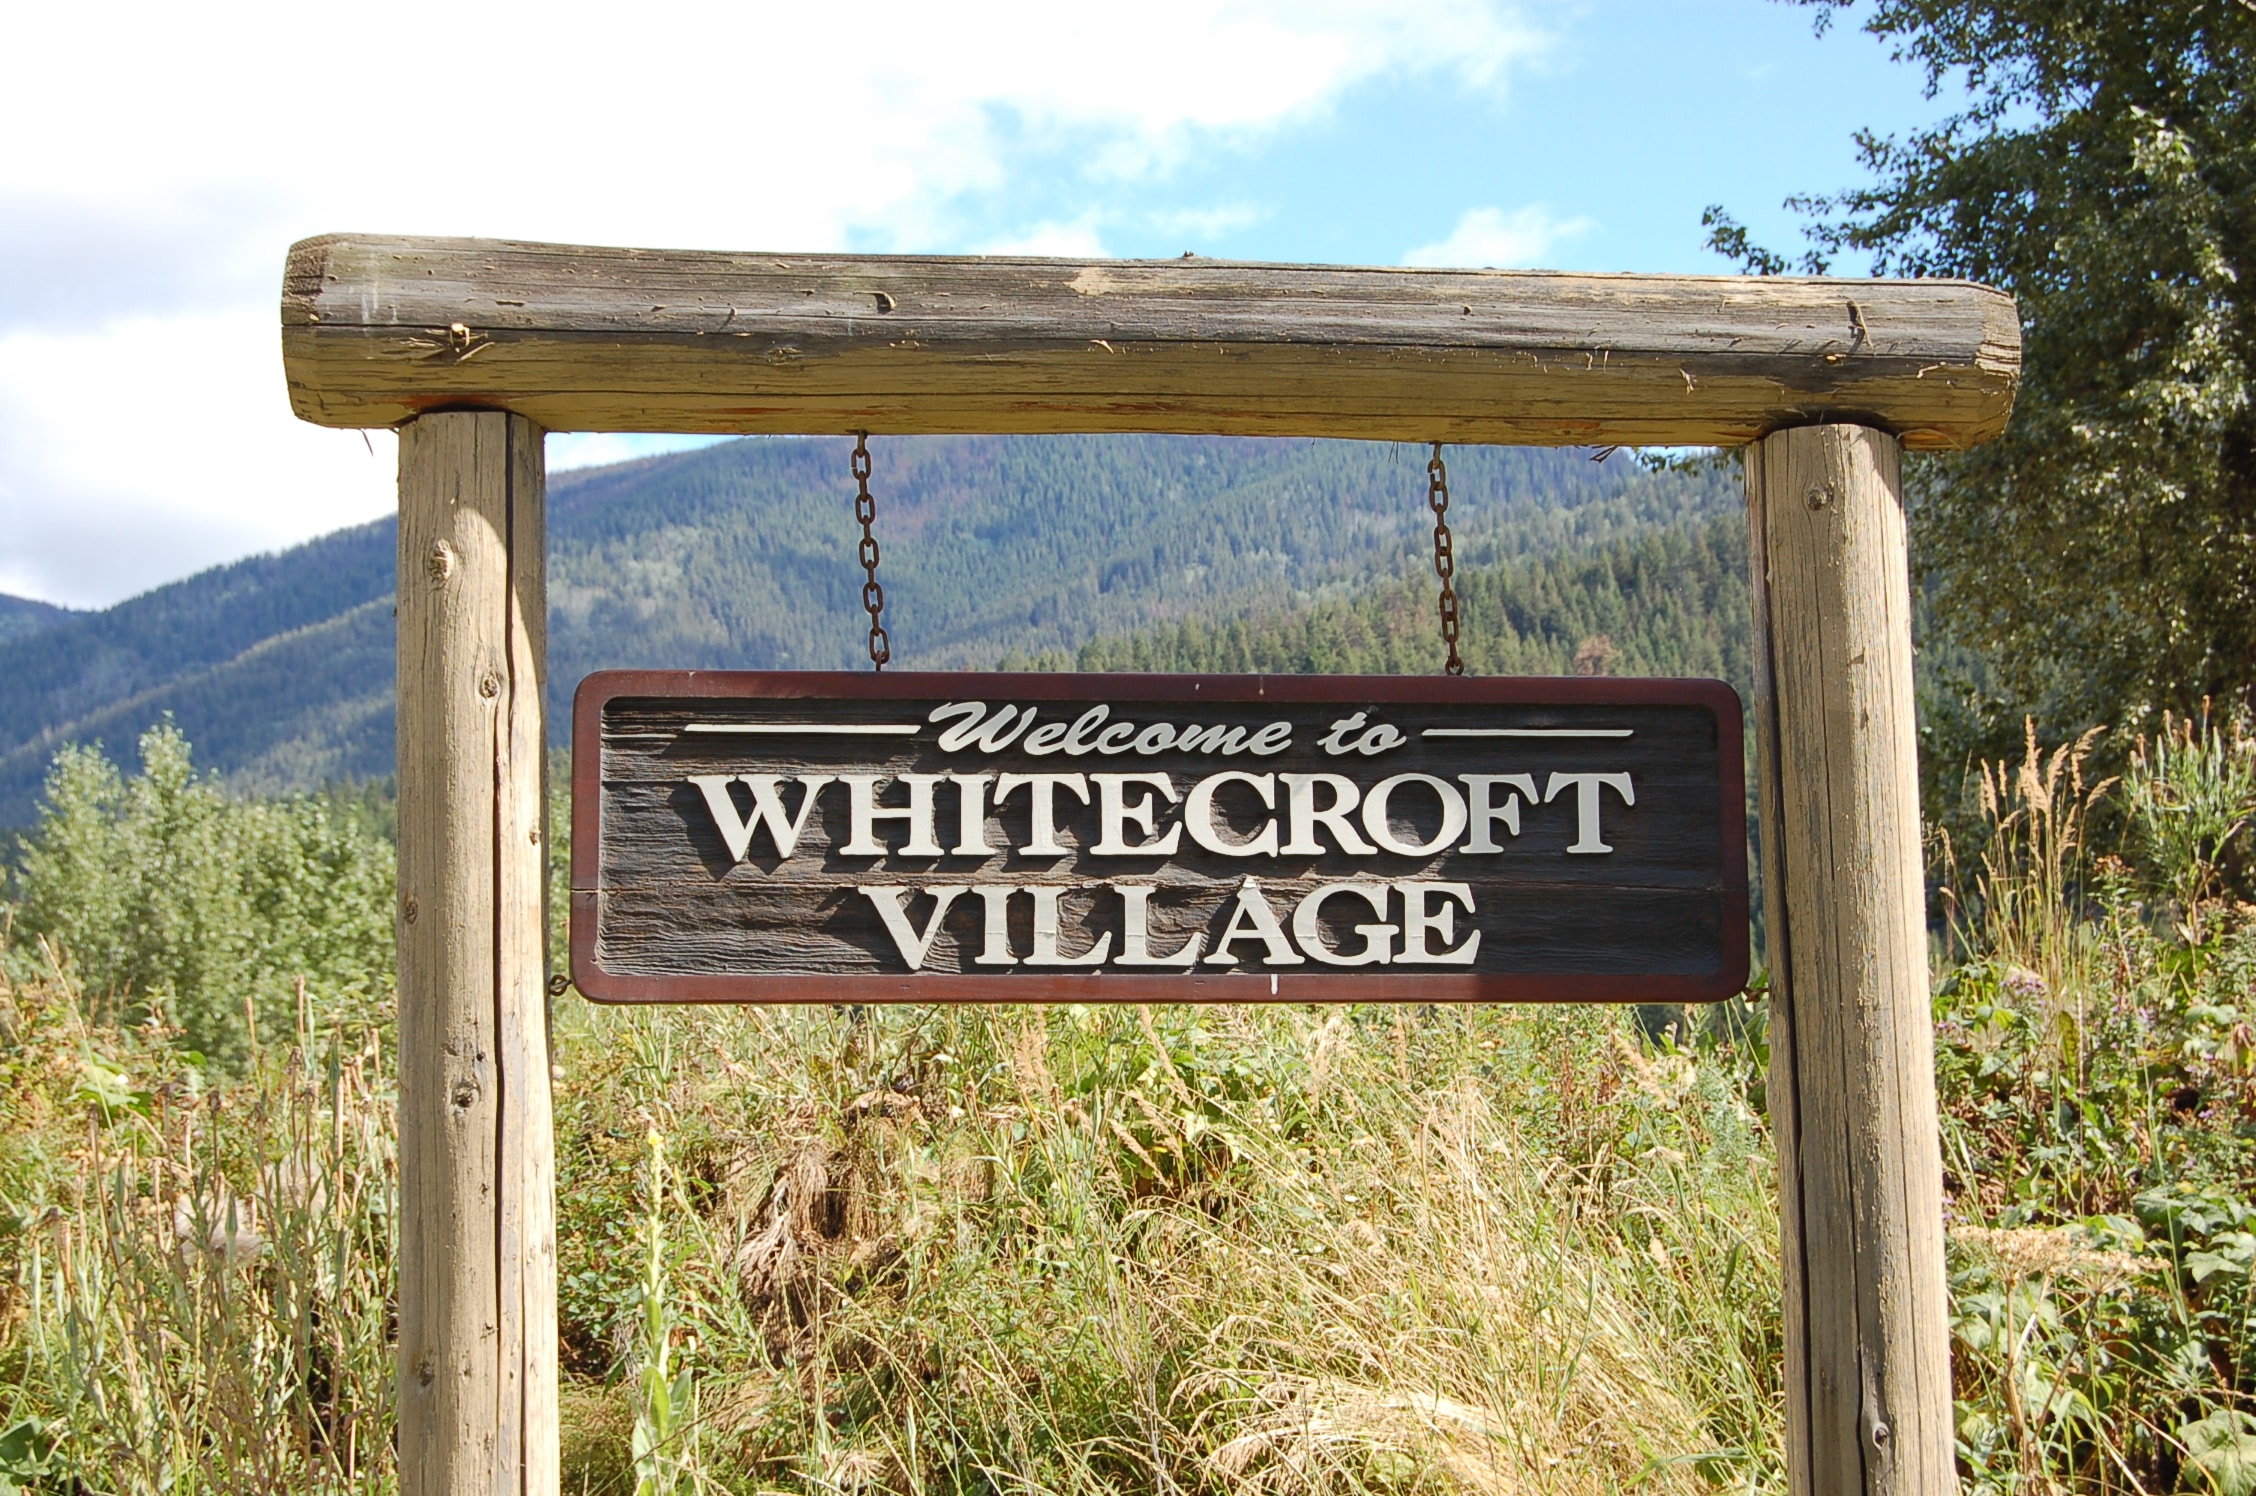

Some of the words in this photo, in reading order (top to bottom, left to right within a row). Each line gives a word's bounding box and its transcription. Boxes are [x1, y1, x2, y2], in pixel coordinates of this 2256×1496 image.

[928, 701, 1293, 756] Welcome
[1316, 711, 1407, 756] to
[686, 770, 1636, 863] WHITECROFT
[857, 875, 1482, 971] VILLAGE
